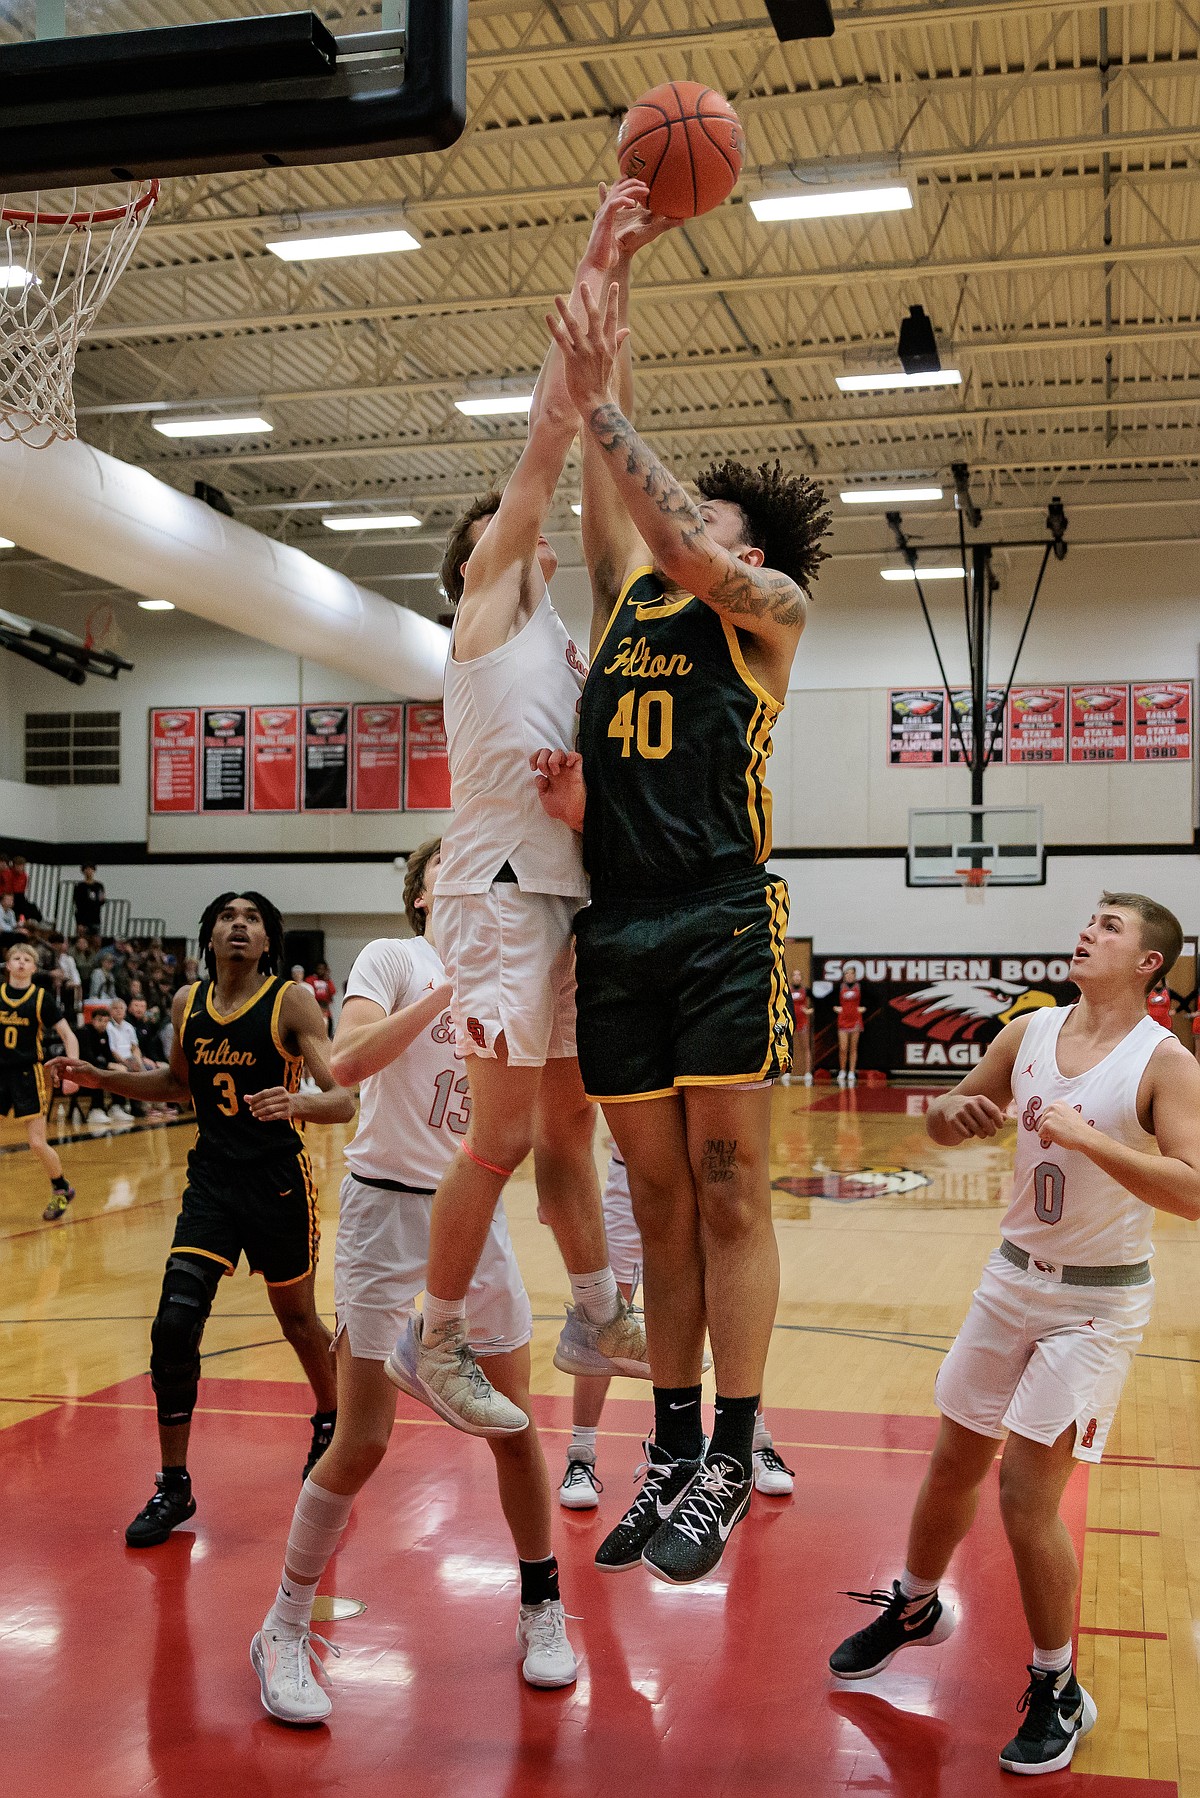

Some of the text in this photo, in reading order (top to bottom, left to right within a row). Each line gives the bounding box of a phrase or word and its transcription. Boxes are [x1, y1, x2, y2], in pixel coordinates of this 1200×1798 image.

[607, 687, 673, 759] 40
[1010, 737, 1064, 750] CHAMPIONS
[1071, 735, 1125, 748] CHAMPIONS
[1134, 733, 1189, 747] CHAMPIONS
[1021, 750, 1053, 761] 1999
[824, 960, 1070, 982] SOUTHERN BOO
[4, 1025, 18, 1050] 0
[193, 1037, 257, 1066] Fulton
[906, 1043, 985, 1066] EAGL
[213, 1072, 239, 1117] 3
[428, 1069, 472, 1135] 13
[1034, 1161, 1066, 1226] 0
